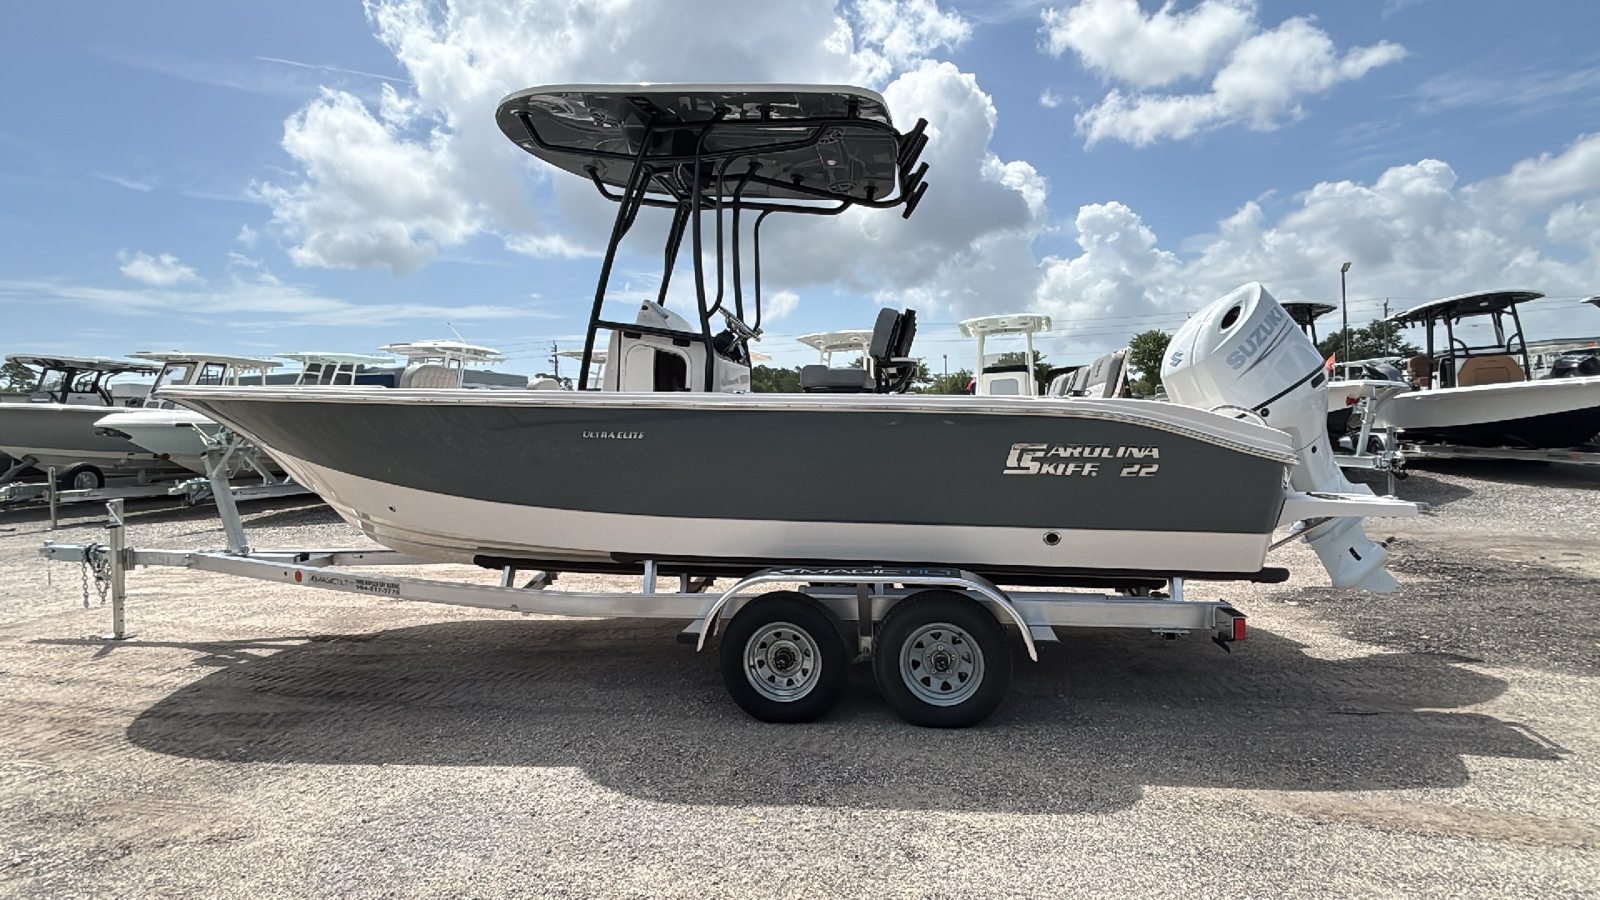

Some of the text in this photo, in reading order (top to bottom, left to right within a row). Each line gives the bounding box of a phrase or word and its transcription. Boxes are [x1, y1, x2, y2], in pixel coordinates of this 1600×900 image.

[1226, 305, 1285, 371] SUZUKI
[582, 430, 645, 440] ULTRA ELITE
[1005, 443, 1160, 468] CAROLINA
[1119, 463, 1160, 477] 22
